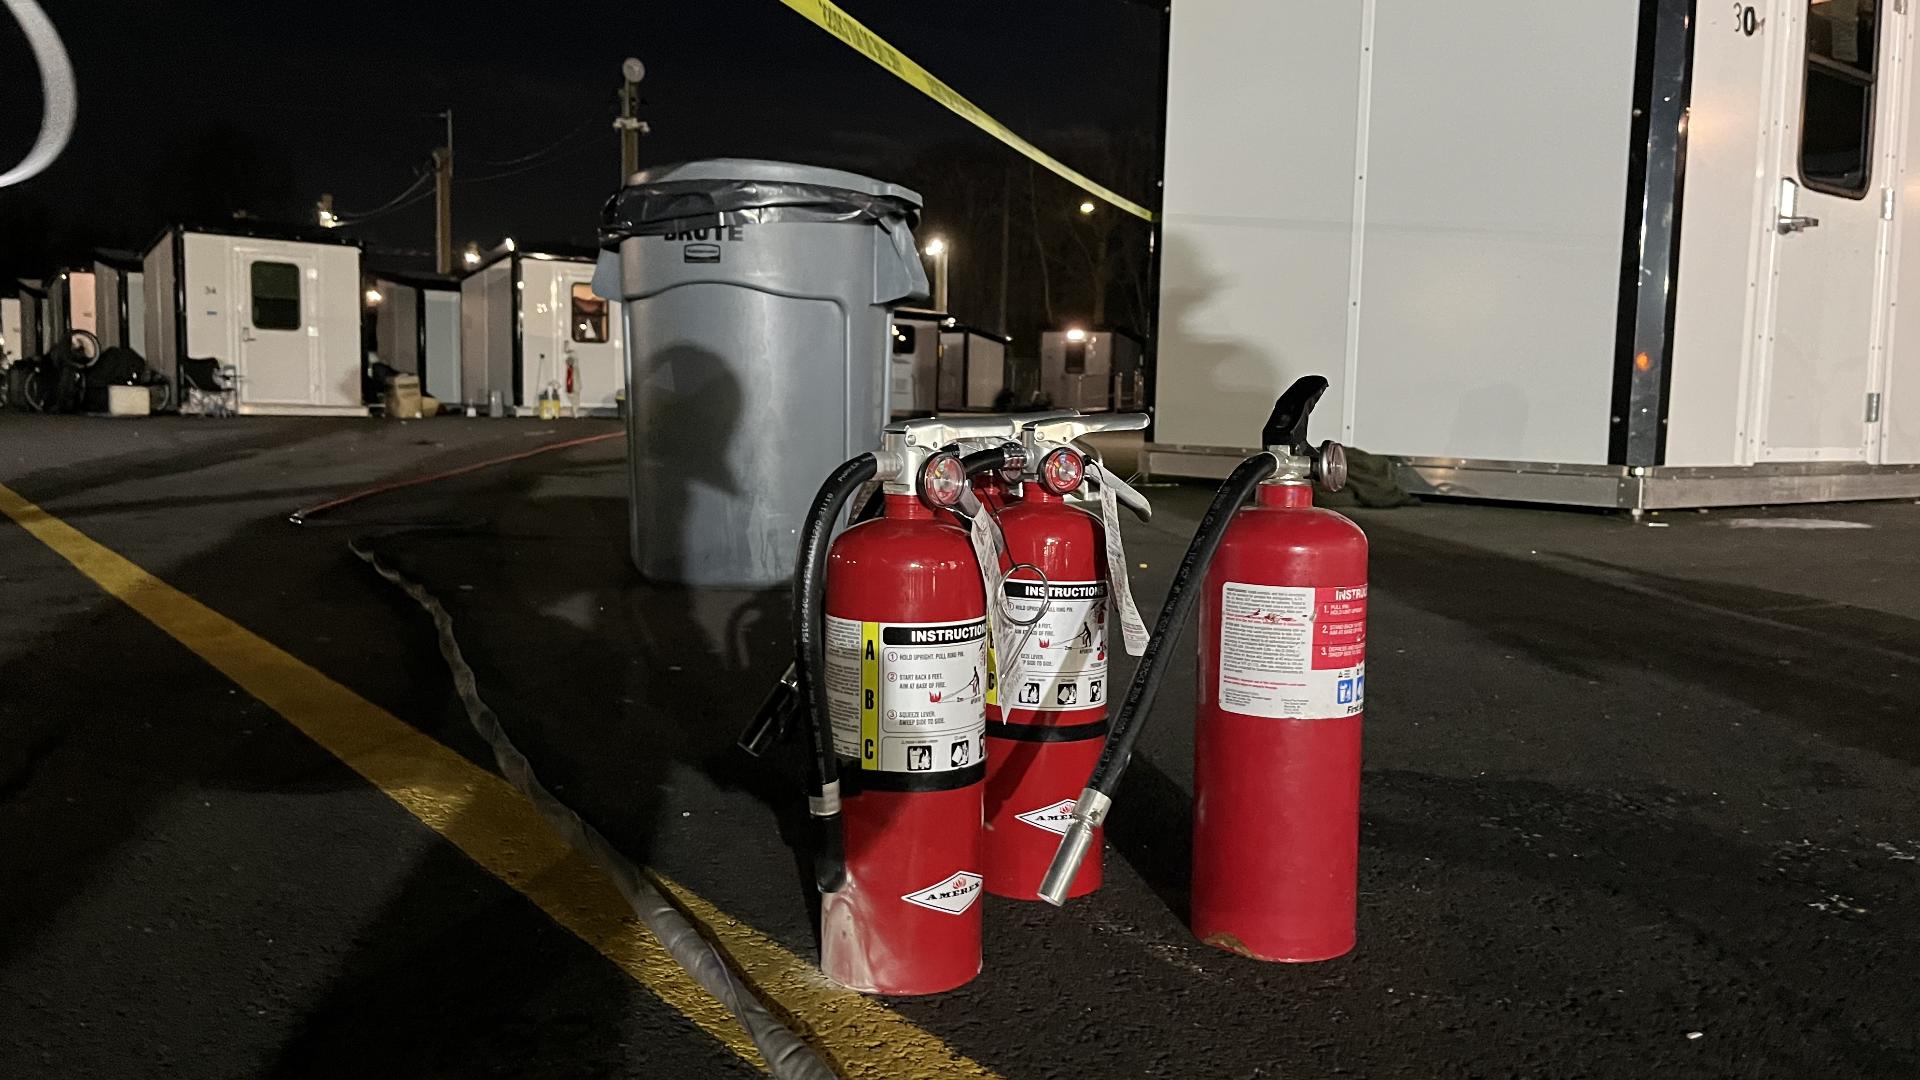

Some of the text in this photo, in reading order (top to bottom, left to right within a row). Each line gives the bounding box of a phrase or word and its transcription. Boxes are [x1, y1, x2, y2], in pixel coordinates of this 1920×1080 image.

[1733, 2, 1755, 37] 30
[1322, 624, 1328, 634] 2.
[866, 640, 874, 660] A
[865, 688, 874, 710] B
[865, 738, 874, 760] C
